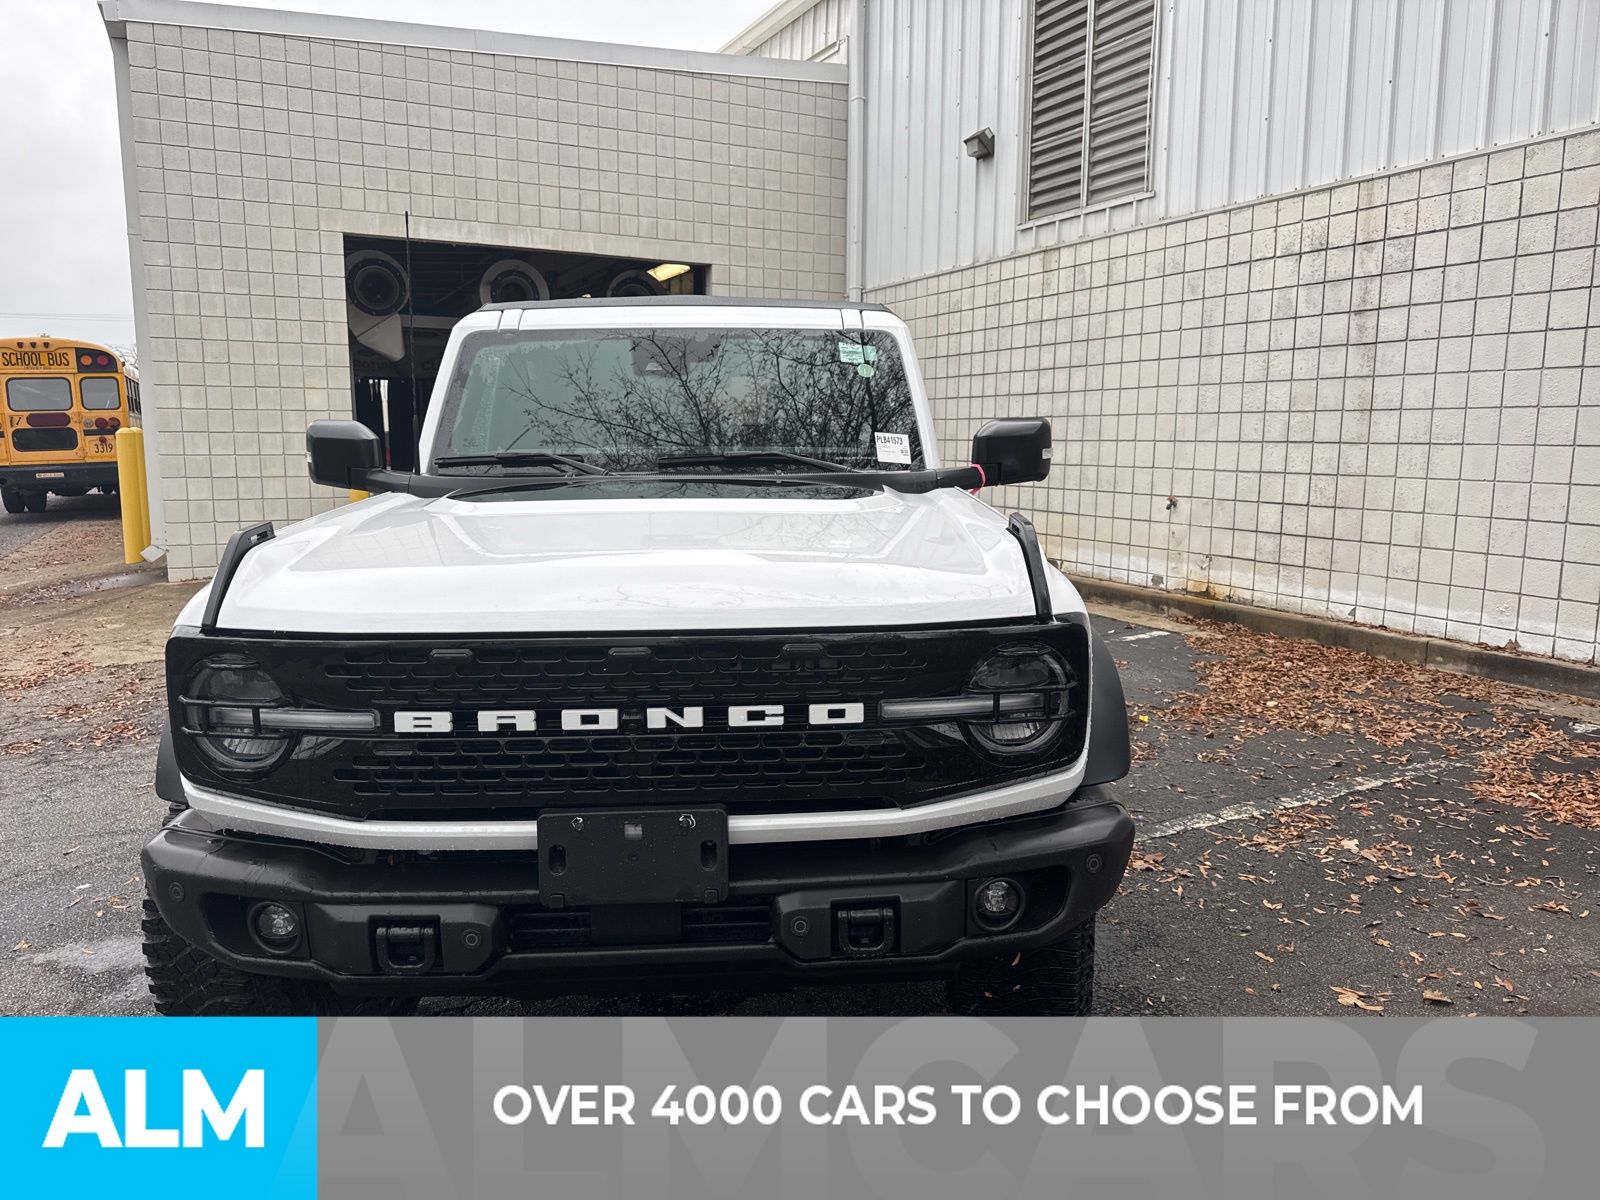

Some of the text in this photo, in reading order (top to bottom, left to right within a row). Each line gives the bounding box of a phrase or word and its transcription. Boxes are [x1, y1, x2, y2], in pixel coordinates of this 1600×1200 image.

[2, 352, 70, 367] SCHOOL BUS
[95, 443, 113, 454] 3319
[393, 702, 865, 734] BRONCO
